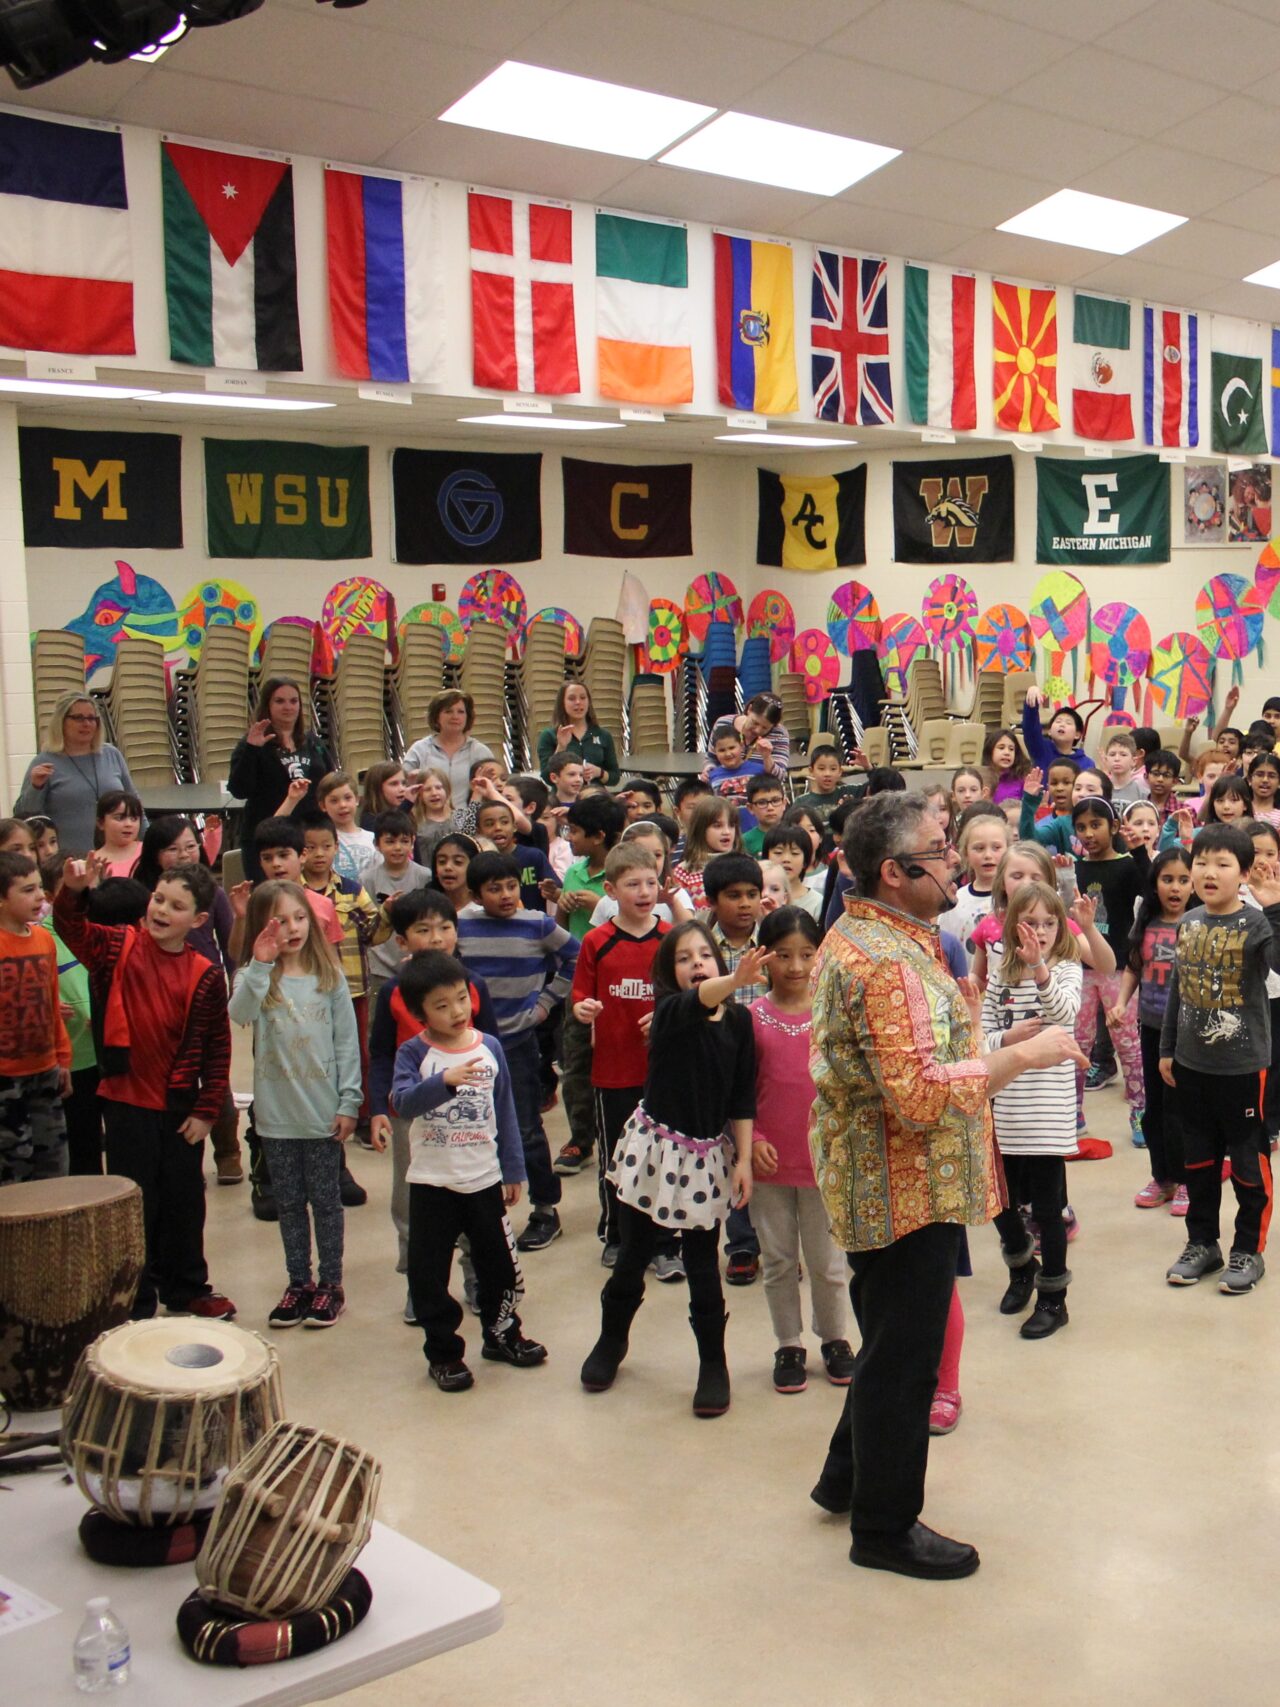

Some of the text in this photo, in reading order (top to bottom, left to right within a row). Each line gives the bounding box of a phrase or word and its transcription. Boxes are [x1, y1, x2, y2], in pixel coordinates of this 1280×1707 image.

[53, 457, 128, 520] M
[226, 473, 349, 527] WSU
[610, 482, 648, 540] C
[919, 477, 989, 548] W
[1081, 473, 1119, 535] E
[1052, 535, 1152, 550] EASTERN MICHIGAN
